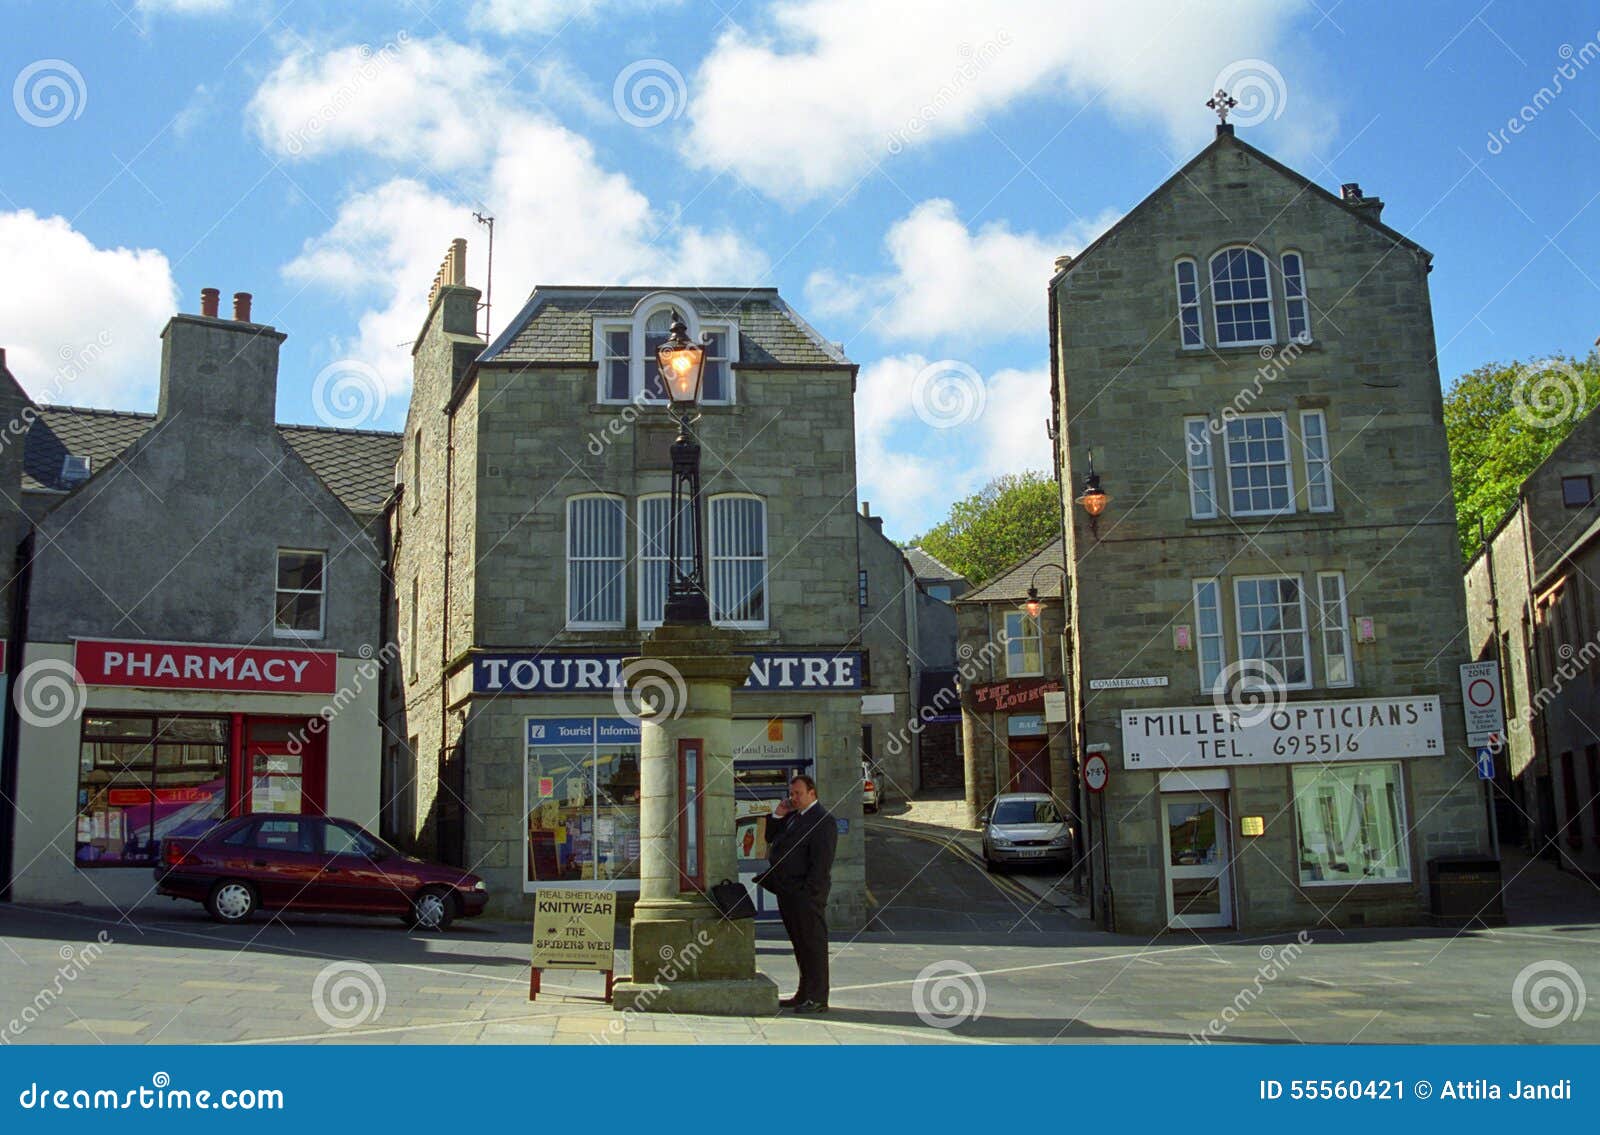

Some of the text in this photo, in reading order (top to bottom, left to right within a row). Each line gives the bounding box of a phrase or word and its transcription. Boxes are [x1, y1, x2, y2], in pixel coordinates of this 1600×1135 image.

[103, 651, 310, 683] PHARMACY
[482, 657, 854, 690] TOURI NTRE
[1468, 668, 1491, 678] ZONE
[1092, 678, 1150, 688] COMMERCIAL
[975, 684, 1010, 702] THE
[996, 682, 1059, 710] LOUNGE
[1145, 703, 1419, 737] MILLER OPTICIANS
[559, 726, 592, 737] Tourist
[733, 744, 794, 754] etland Islands
[1197, 734, 1360, 760] TEL. 695516
[540, 890, 613, 901] REAL SHETLAND
[539, 901, 613, 915] KNITWEAR
[568, 916, 580, 924] AT
[566, 927, 586, 938] THE
[587, 941, 611, 951] WEB
